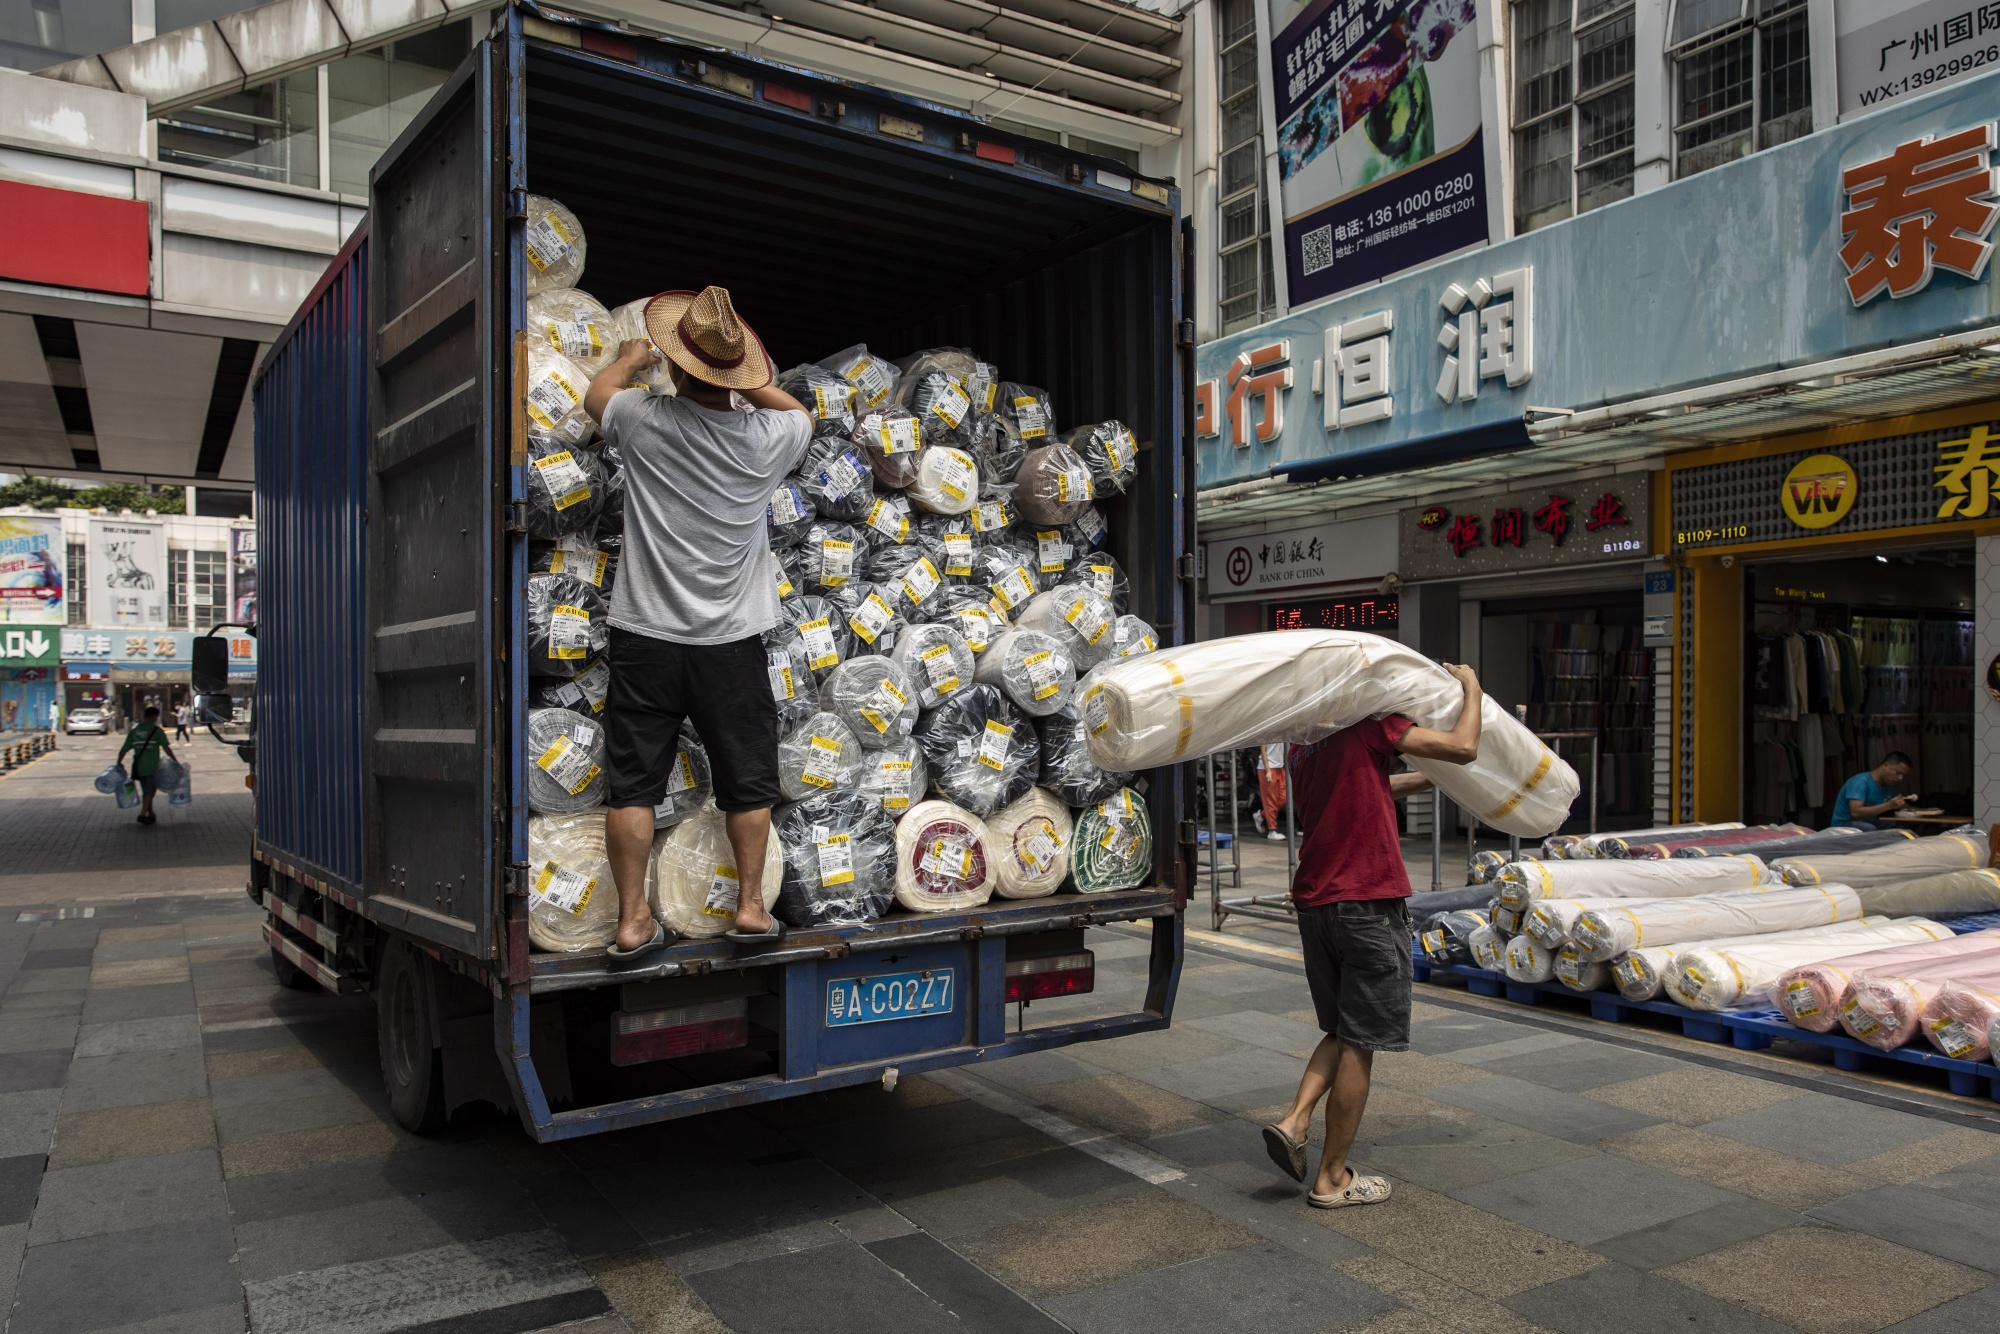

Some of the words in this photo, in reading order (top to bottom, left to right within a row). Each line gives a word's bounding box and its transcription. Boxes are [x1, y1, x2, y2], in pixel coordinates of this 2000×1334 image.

[1367, 206, 1392, 229] 136
[1396, 190, 1431, 218] 1000
[1434, 172, 1473, 203] 6280
[1837, 121, 2000, 307] 泰
[1311, 264, 1535, 432] 恒润
[1932, 425, 2000, 518] 泰
[1447, 494, 1625, 557] 恒润布业
[1603, 540, 1640, 553] B1108
[1677, 525, 1748, 544] B1109-1110
[1260, 573, 1281, 583] BANK
[1284, 571, 1294, 580] OF
[1296, 568, 1325, 578] CHINA
[1653, 580, 1667, 592] 23
